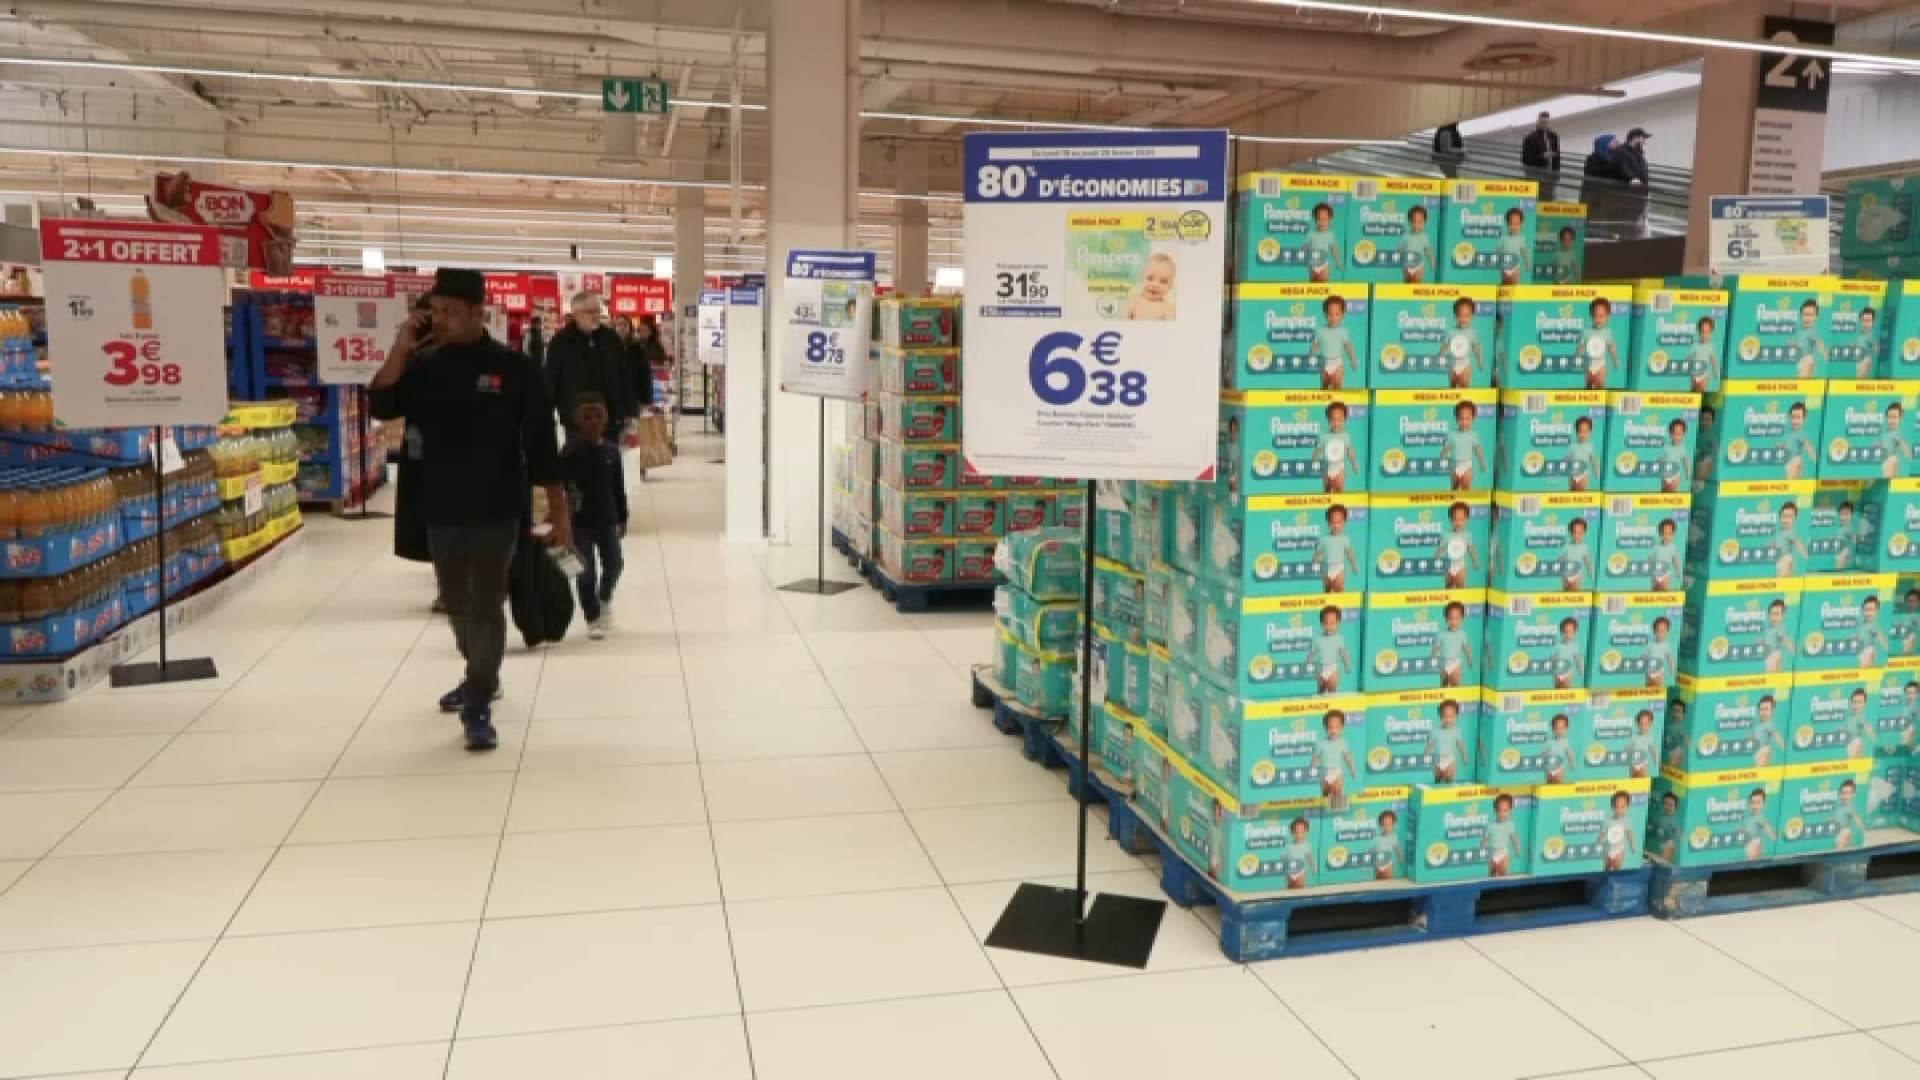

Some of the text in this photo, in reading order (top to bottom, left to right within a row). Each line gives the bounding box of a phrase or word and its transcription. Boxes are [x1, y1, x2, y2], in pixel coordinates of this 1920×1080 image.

[1765, 31, 1800, 88] 2
[1039, 173, 1182, 197] D'ÉCONOMIES
[64, 238, 201, 264] 2+1 OFFERT
